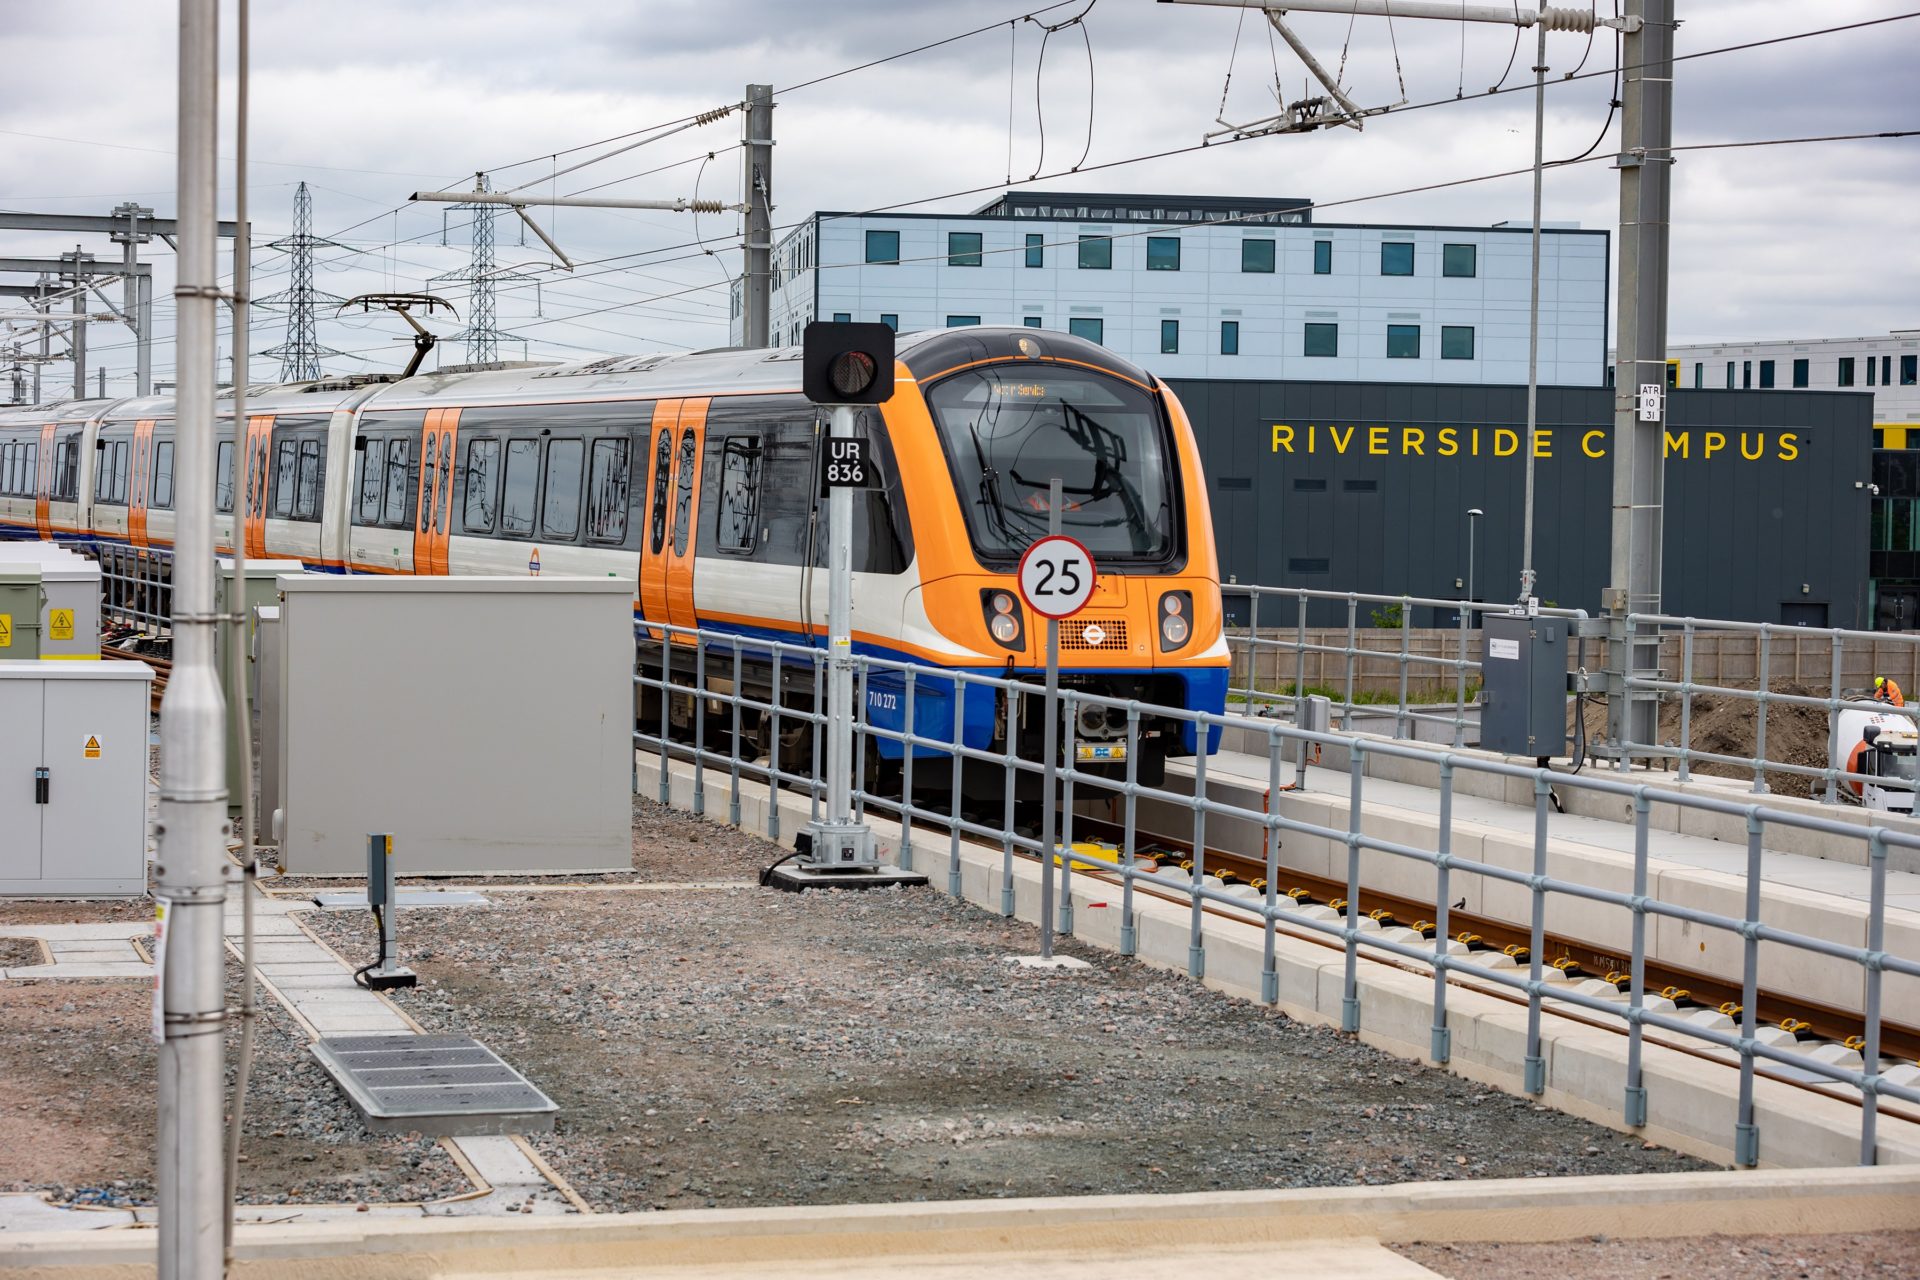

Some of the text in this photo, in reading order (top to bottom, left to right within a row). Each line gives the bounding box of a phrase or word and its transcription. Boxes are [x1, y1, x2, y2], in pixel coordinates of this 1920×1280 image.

[1642, 386, 1660, 395] ATR
[1645, 398, 1655, 408] 10
[1646, 410, 1655, 420] 31
[831, 441, 860, 460] UR
[1271, 424, 1799, 462] RIVERSIDE CMPUS
[827, 463, 864, 482] 836
[1034, 558, 1081, 596] 25
[869, 691, 897, 710] 710 272
